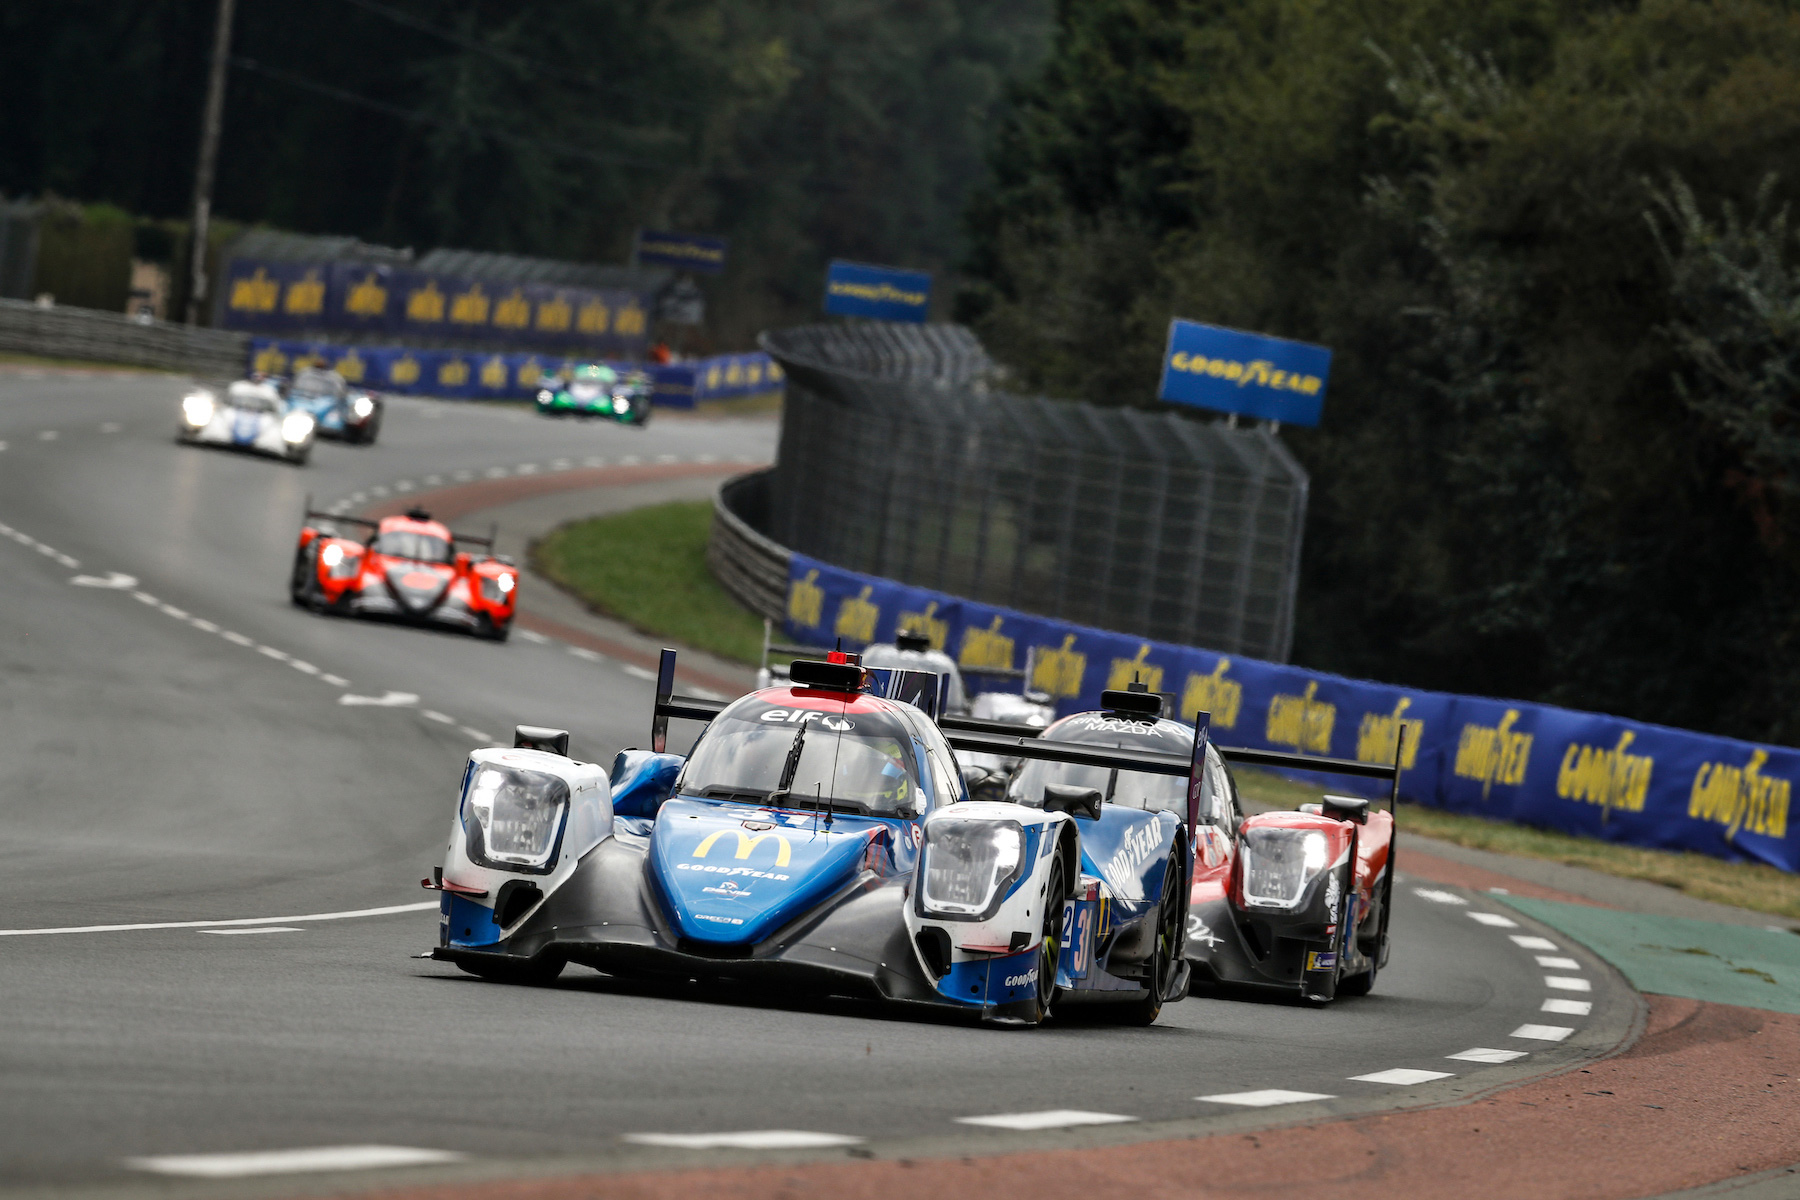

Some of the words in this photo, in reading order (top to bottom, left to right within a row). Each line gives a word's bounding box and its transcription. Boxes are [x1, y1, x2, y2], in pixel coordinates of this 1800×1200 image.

[1171, 352, 1322, 396] GOODYEAR
[760, 709, 823, 724] elf
[1066, 717, 1186, 737] RINGWOOD
[1084, 722, 1163, 738] MAZDA
[676, 863, 790, 881] GOODYEAR
[1074, 908, 1093, 972] 31
